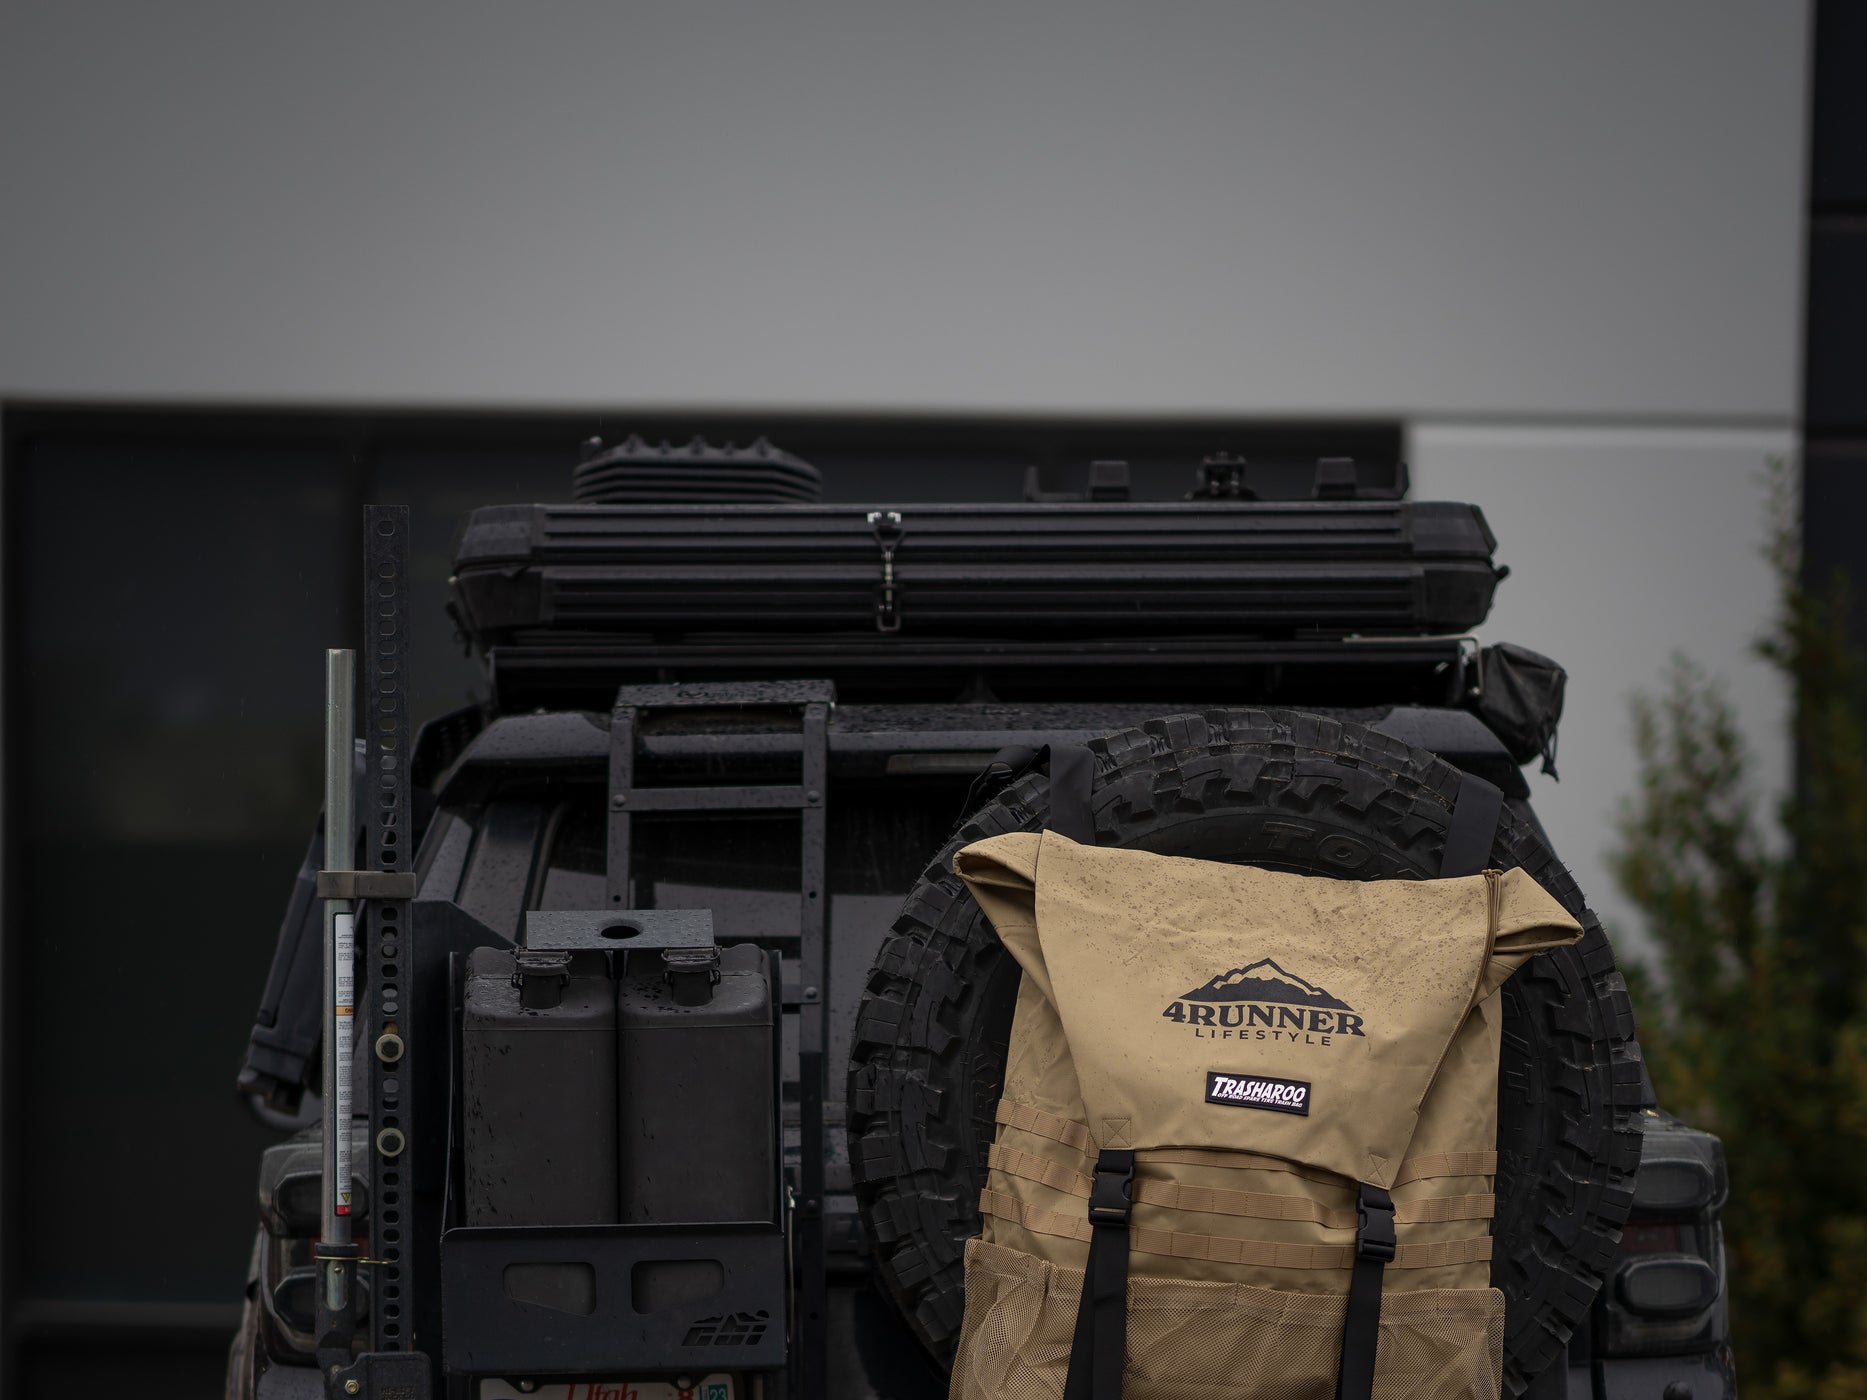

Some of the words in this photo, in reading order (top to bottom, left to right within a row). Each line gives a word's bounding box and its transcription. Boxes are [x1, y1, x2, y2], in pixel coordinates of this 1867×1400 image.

[1162, 1001, 1366, 1037] 4RUNNER
[1195, 1028, 1331, 1047] LIFESTYLE
[1211, 1076, 1306, 1102] TRASHAROO
